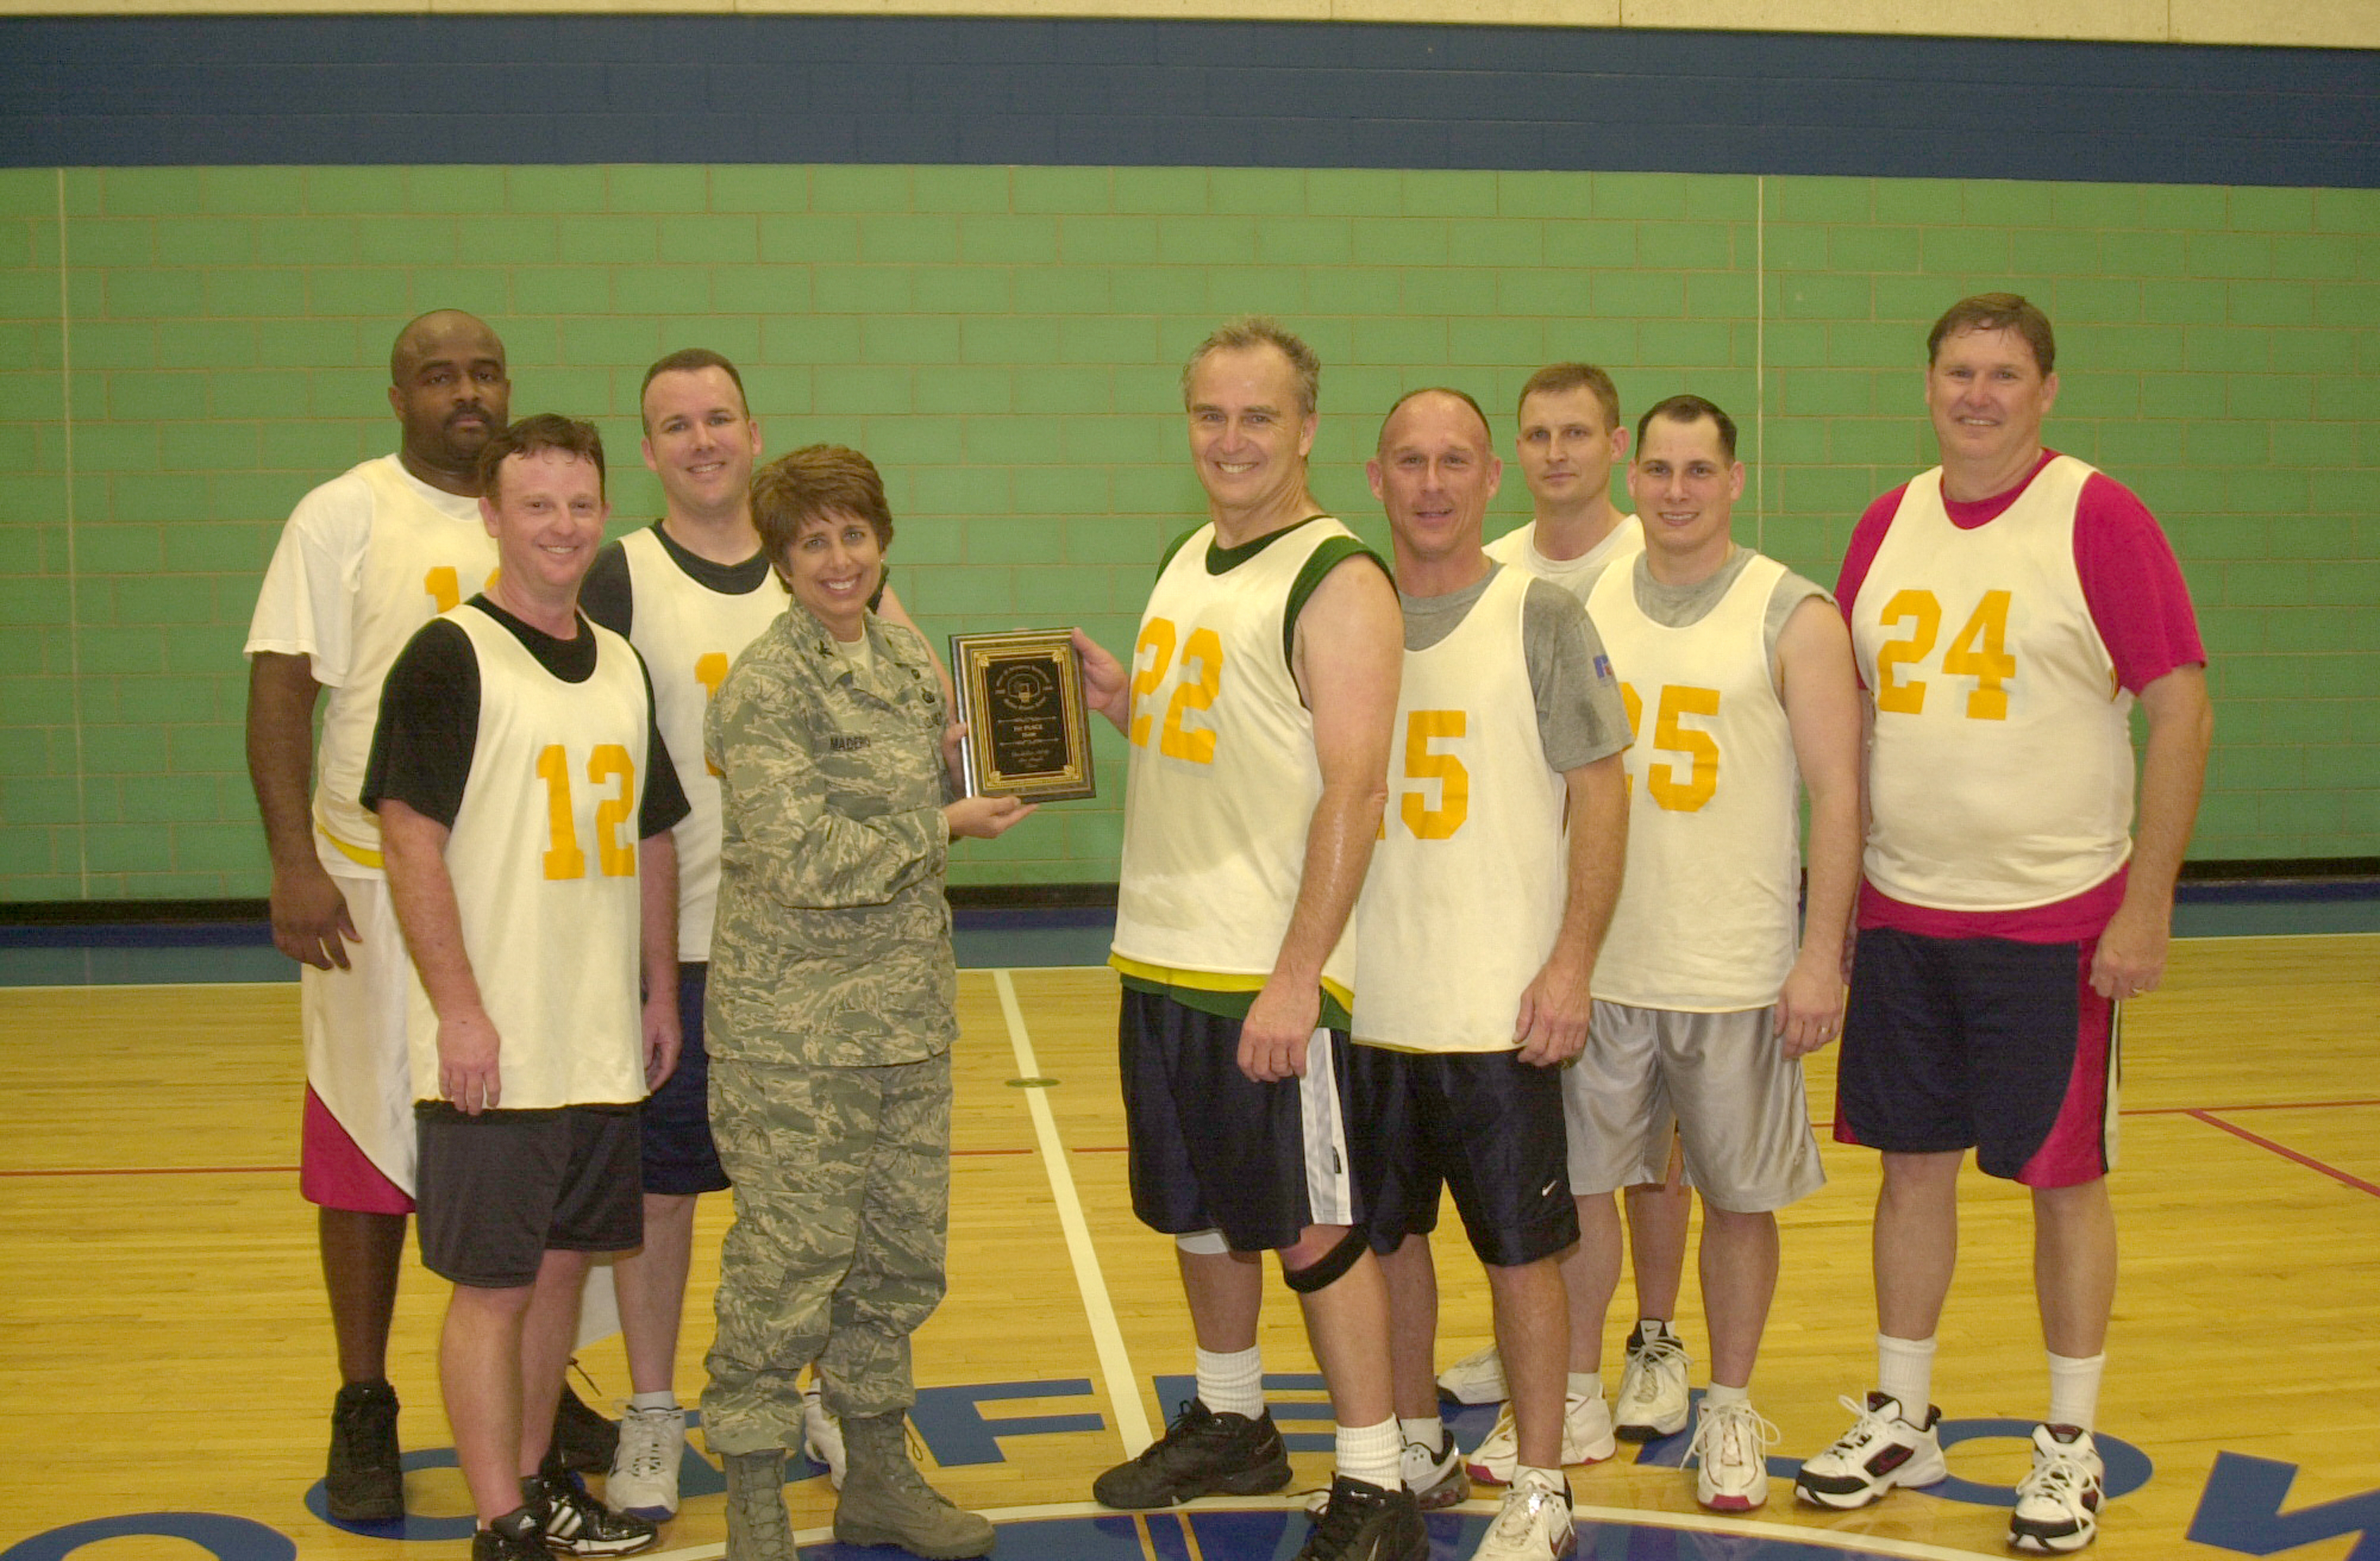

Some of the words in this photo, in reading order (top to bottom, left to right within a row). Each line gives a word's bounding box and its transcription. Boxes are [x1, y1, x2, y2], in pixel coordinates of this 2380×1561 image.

[1130, 616, 1223, 765] 22
[1877, 589, 2016, 720] 24
[536, 744, 635, 880] 12
[1376, 710, 1468, 839] 5
[1618, 682, 1721, 812] 5
